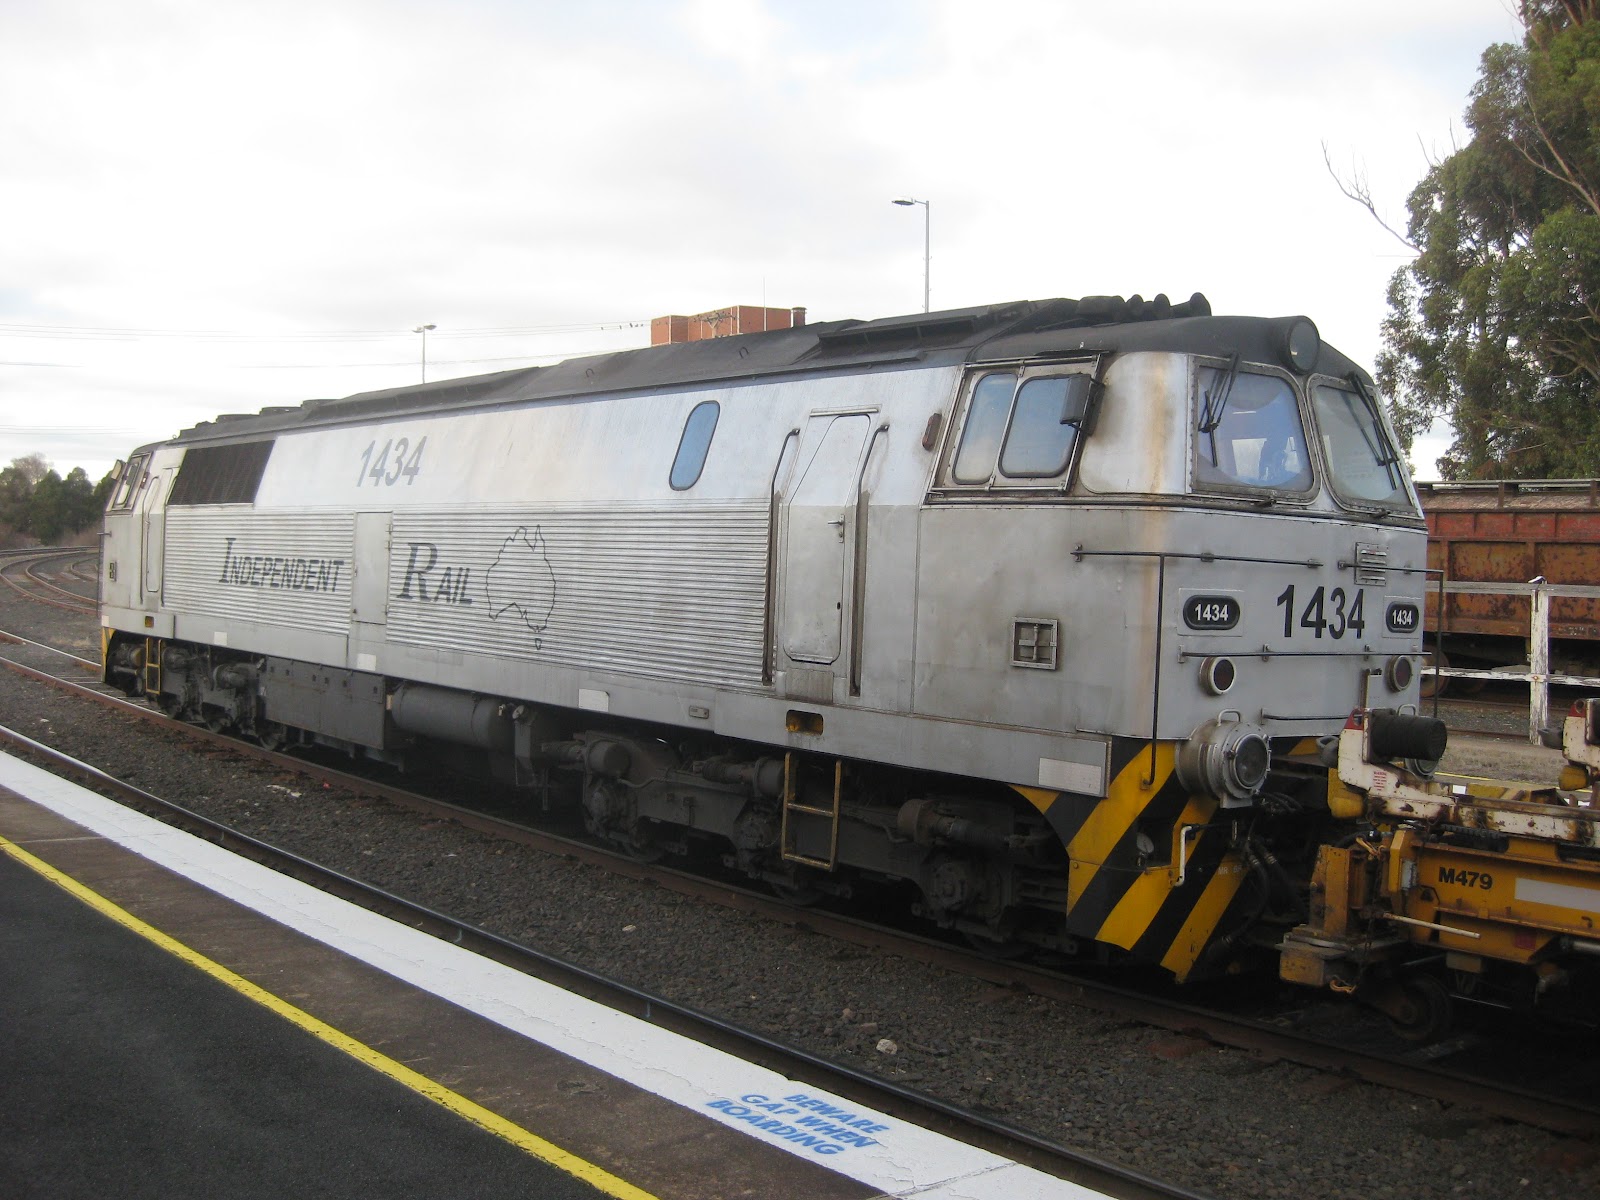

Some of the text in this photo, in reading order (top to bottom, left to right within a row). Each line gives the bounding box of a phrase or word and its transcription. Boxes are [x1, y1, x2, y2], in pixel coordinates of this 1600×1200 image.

[356, 435, 428, 487] 1434
[218, 537, 473, 605] INDEPENDENT RAIL
[1194, 603, 1229, 622] 1434
[1276, 584, 1365, 640] 1434
[1392, 609, 1412, 626] 1434
[1438, 866, 1493, 890] M479
[706, 1099, 846, 1155] BOARDING
[741, 1094, 878, 1148] GAP WHEN
[783, 1094, 890, 1134] BEWARE
